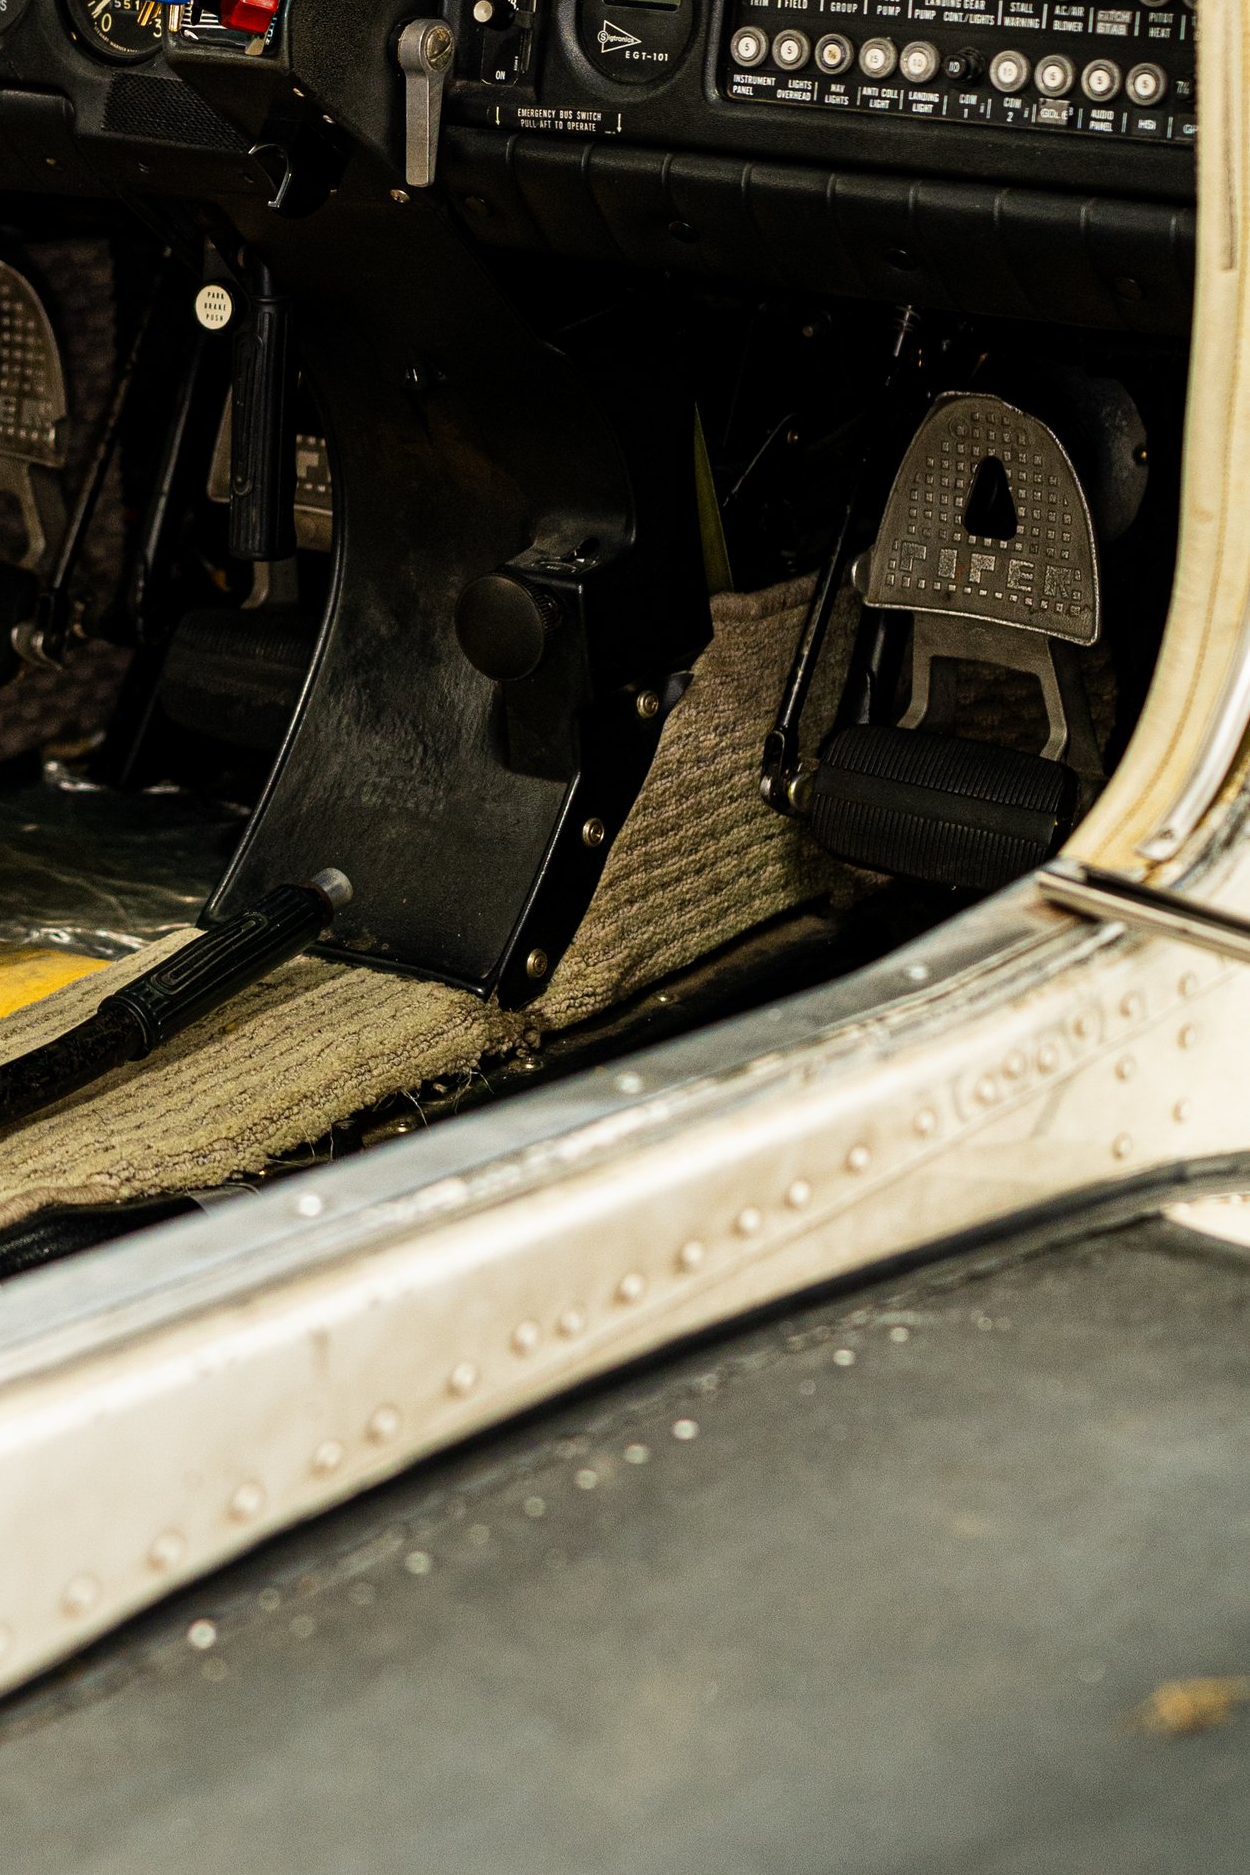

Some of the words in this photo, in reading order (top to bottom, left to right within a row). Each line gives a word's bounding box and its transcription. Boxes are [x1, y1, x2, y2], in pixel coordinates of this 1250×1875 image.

[830, 2, 858, 13] GROUP
[876, 5, 901, 16] PUMP
[1009, 1, 1034, 13] STALL
[914, 8, 937, 20] PUMP
[101, 13, 112, 33] 0
[1003, 15, 1041, 29] WARNING
[1053, 19, 1084, 32] BLOWER
[494, 70, 506, 81] ON
[733, 74, 776, 86] INSTRUMENT
[788, 79, 812, 91] LIGHTS
[732, 85, 754, 96] PANEL
[776, 89, 812, 102] OVERHEAD
[862, 86, 878, 96] ANTI
[881, 88, 899, 99] COLL
[908, 91, 940, 102] LANDING
[824, 94, 850, 106] LIGHTS
[868, 99, 890, 110] LIGHT
[912, 102, 934, 114] LIGHT
[517, 107, 556, 119] EMERGENCY
[559, 109, 573, 119] BUS
[576, 110, 602, 122] SWITCH
[520, 118, 537, 128] PULL
[539, 119, 552, 129] AFT
[554, 120, 564, 130] TO
[566, 120, 597, 132] OPERATE
[207, 291, 225, 300] PARK
[204, 302, 226, 311] BRAKE
[205, 313, 224, 322] PUSH
[899, 540, 1074, 600] PIPER
